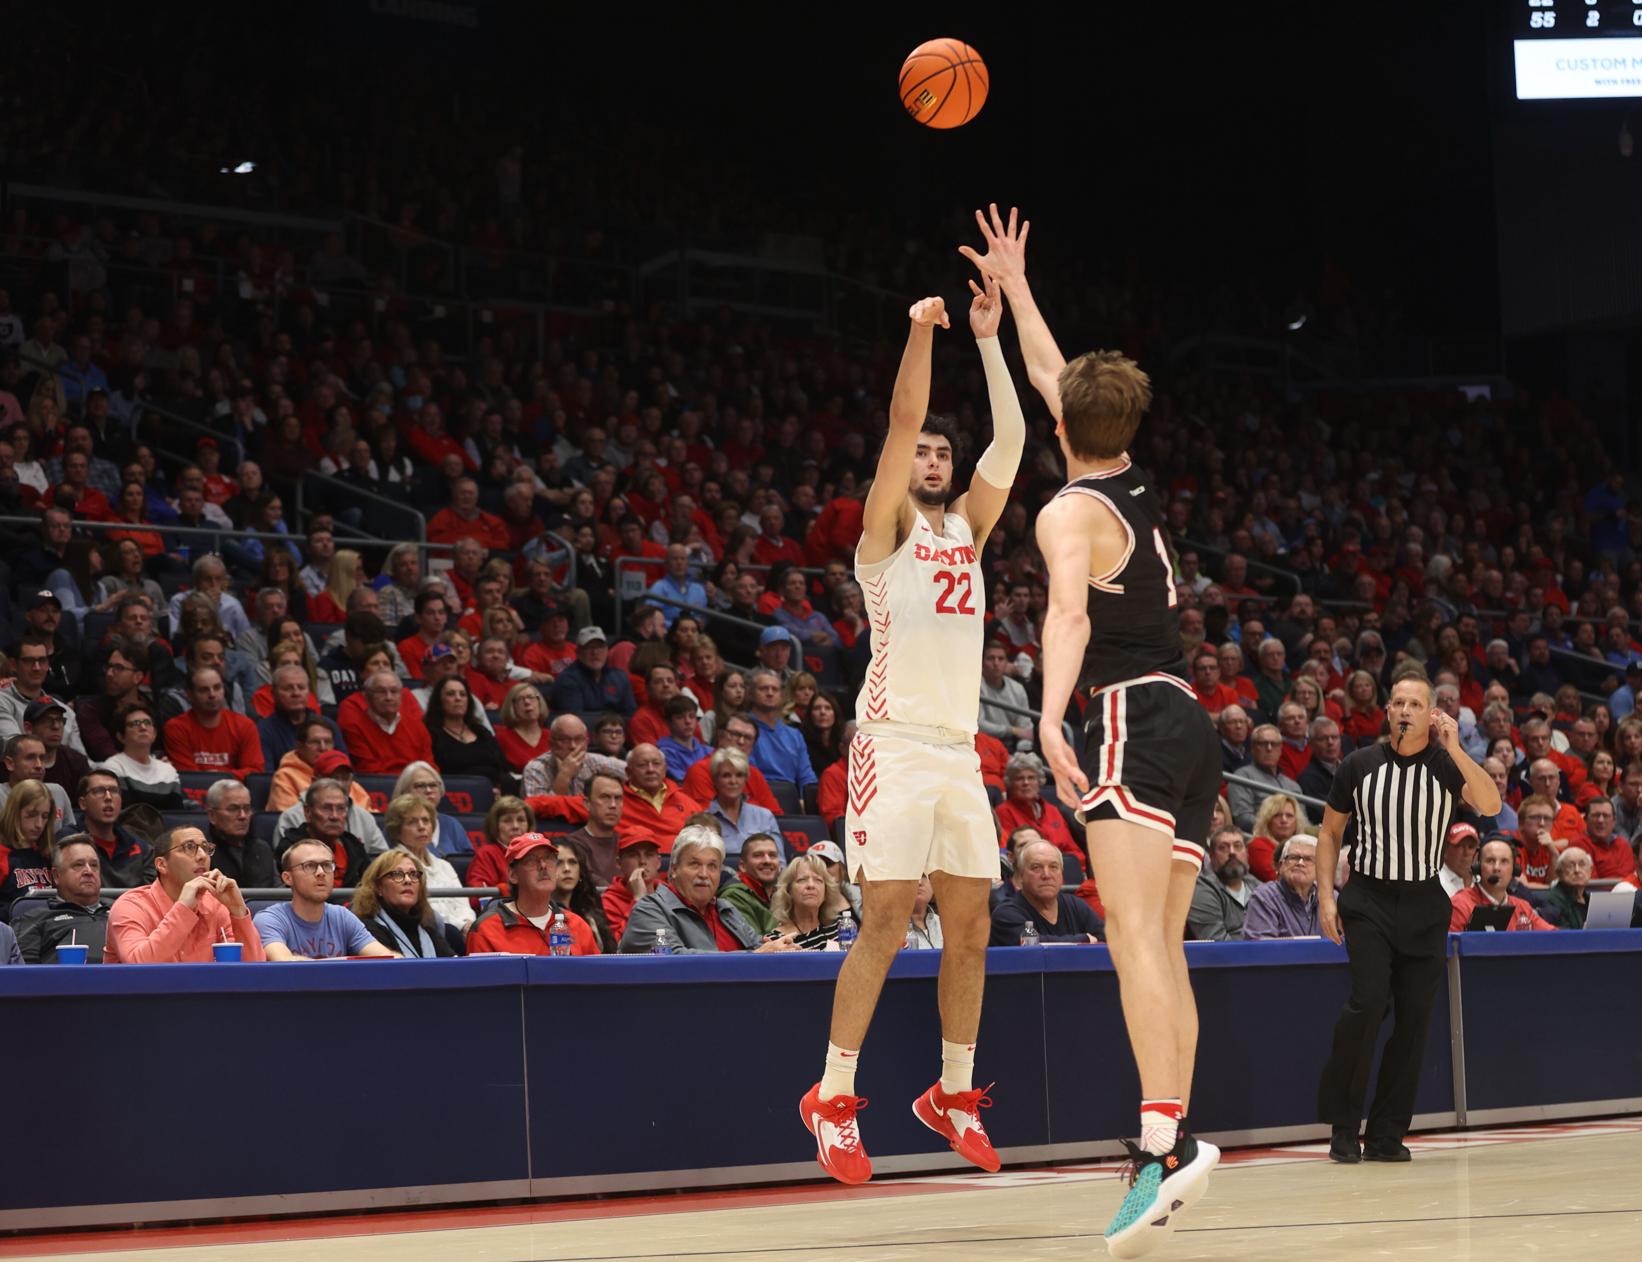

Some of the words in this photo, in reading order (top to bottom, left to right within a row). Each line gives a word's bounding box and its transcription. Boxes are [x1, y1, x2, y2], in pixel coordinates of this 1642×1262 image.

[1530, 11, 1556, 28] 55
[1555, 57, 1627, 72] CUSTOM
[1153, 523, 1178, 609] 1
[933, 570, 976, 616] 22
